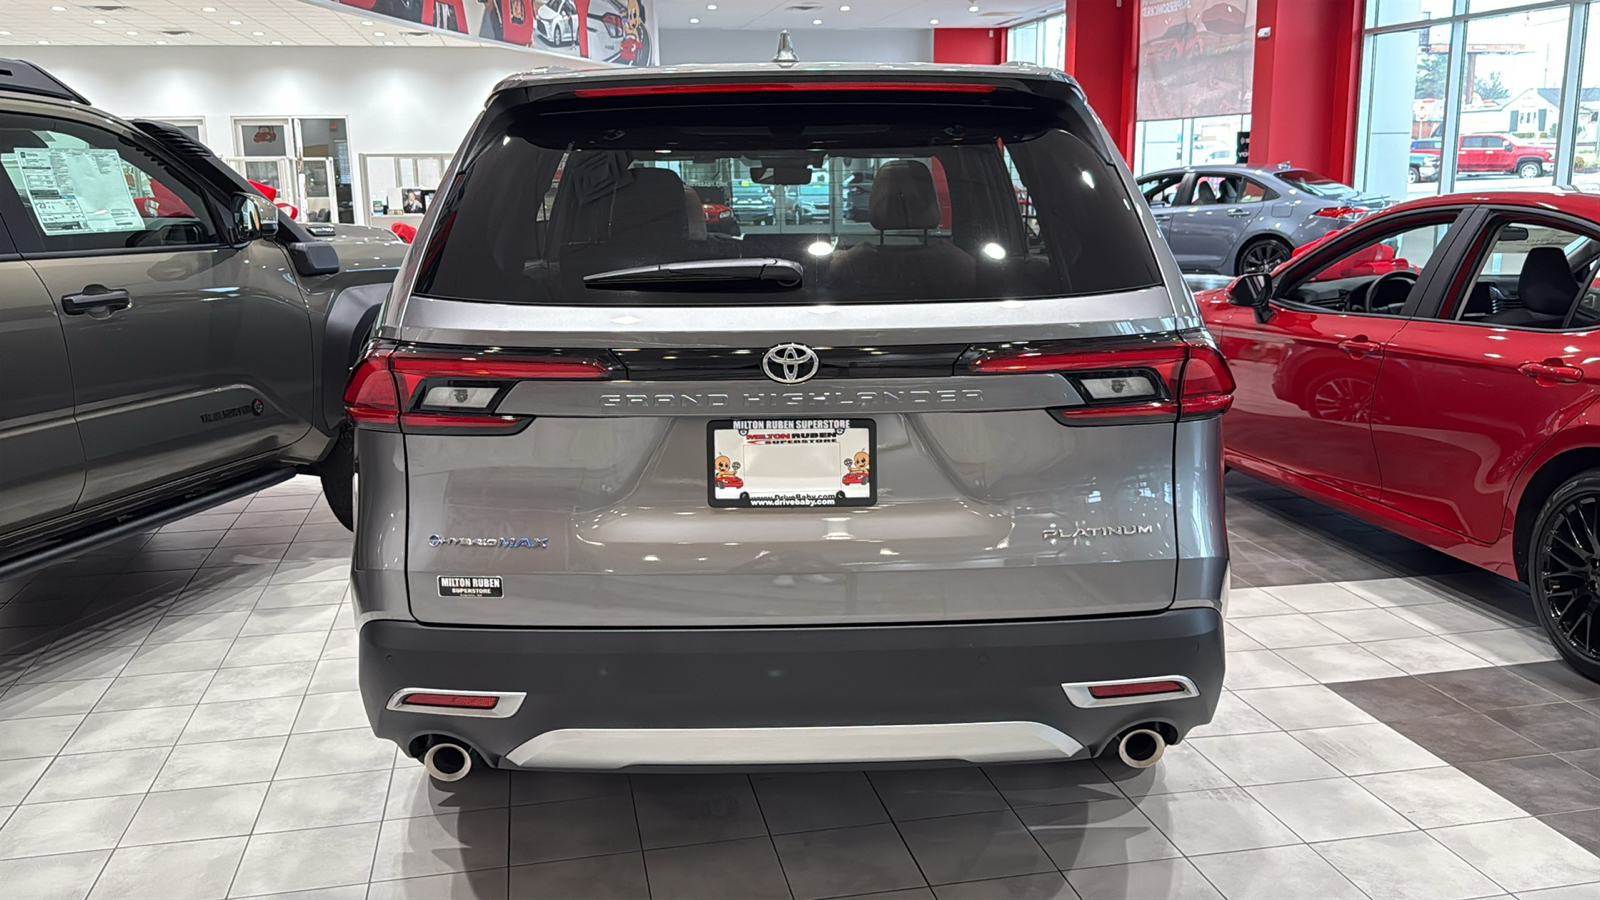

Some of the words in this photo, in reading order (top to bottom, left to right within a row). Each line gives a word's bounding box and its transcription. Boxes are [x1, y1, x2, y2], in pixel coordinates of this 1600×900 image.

[601, 394, 729, 407] GRAND
[743, 389, 984, 407] HIGHLANDER
[733, 420, 765, 430] MILTON
[766, 420, 794, 430] RUBEN
[796, 419, 851, 429] SUPERSTORE
[746, 433, 791, 441] MILTON
[751, 499, 836, 507] www.drivebaby.com
[1042, 525, 1153, 539] PLATINUM
[441, 578, 472, 588] MILTON
[473, 578, 501, 588] RUBEN
